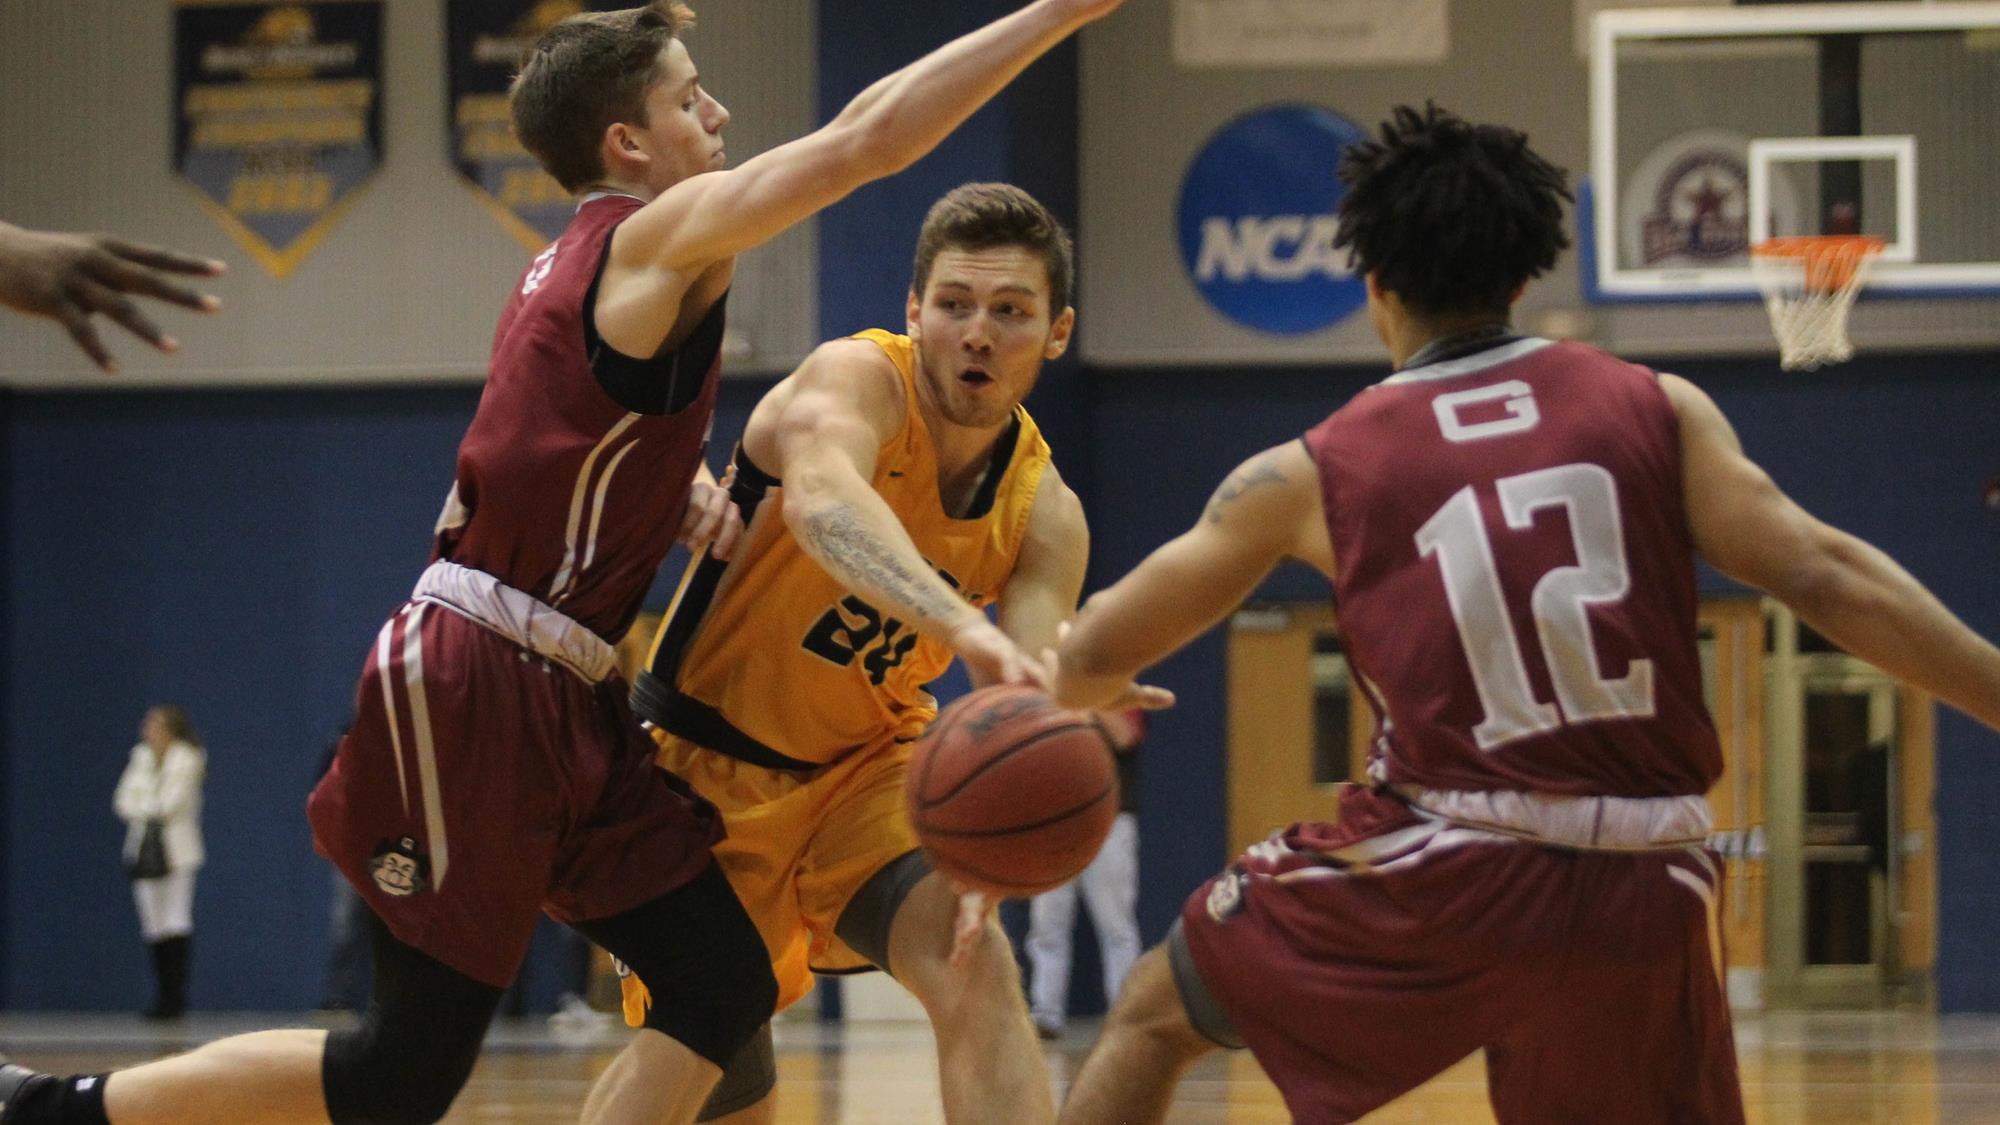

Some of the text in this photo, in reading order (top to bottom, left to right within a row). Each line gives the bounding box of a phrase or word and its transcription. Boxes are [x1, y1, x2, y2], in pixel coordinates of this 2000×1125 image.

[1197, 215, 1361, 281] NCA
[1432, 379, 1541, 441] G
[801, 594, 918, 686] 24
[1413, 463, 1656, 751] 12
